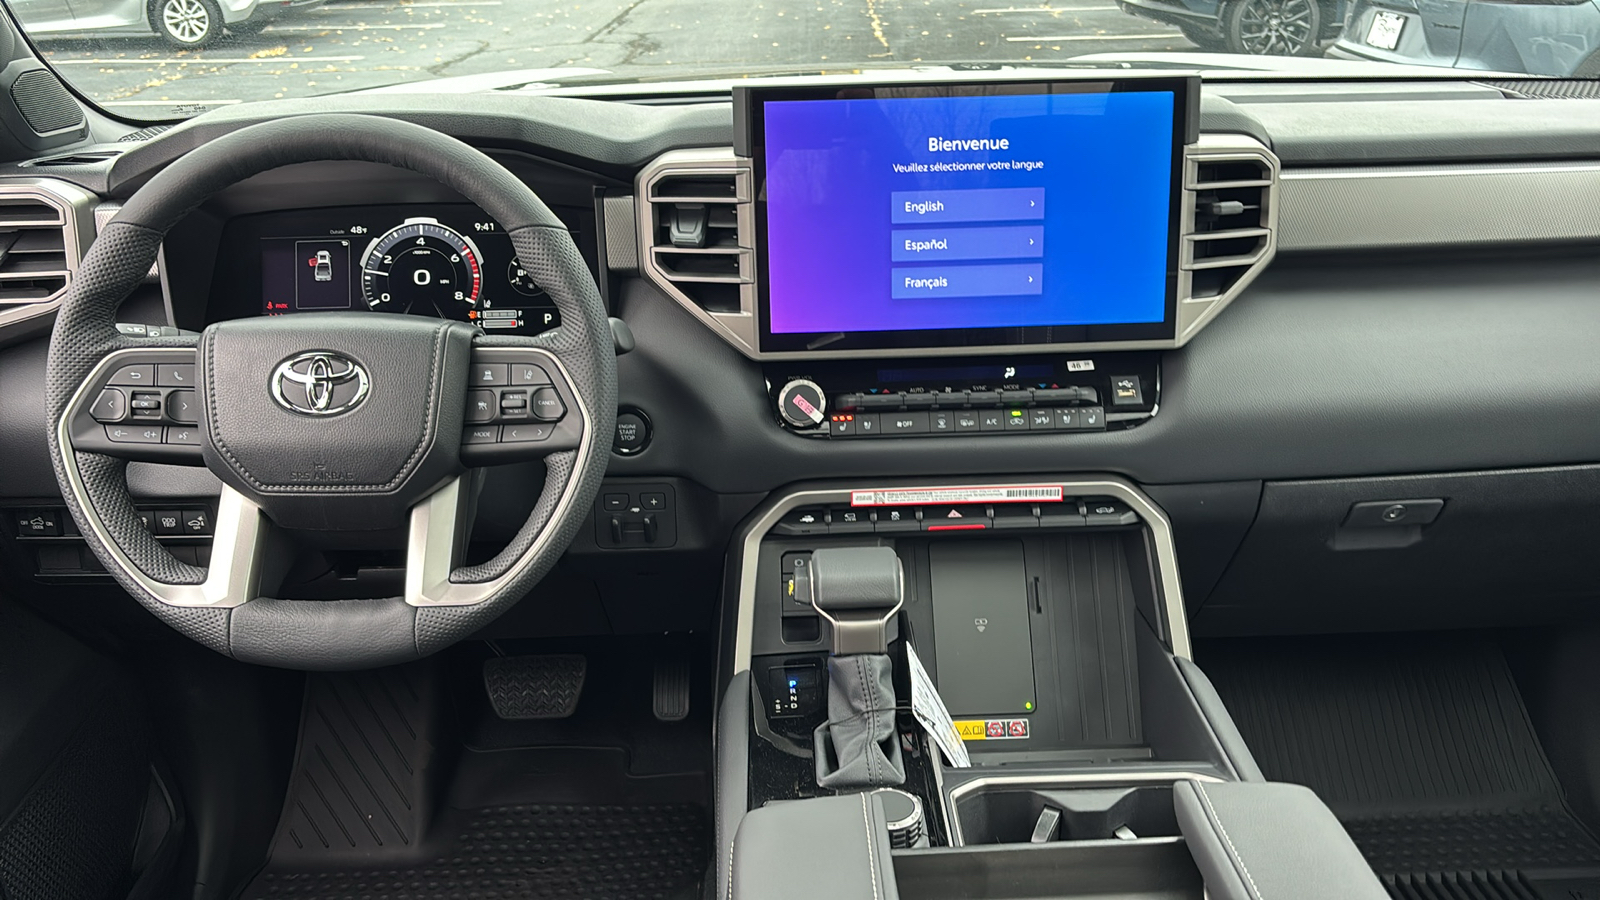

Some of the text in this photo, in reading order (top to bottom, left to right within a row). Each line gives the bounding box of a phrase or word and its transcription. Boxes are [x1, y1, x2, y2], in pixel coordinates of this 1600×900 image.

[928, 136, 1010, 152] Bienvenue
[892, 159, 1045, 173] Veuillez sélectionner votre langue
[904, 200, 945, 215] English
[474, 222, 495, 232] 9:41
[416, 237, 426, 246] 4
[904, 238, 948, 253] Español
[383, 255, 393, 264] 2
[450, 253, 460, 262] 6
[413, 269, 431, 286] 0
[904, 276, 949, 290] Français
[381, 293, 391, 302] 0
[454, 291, 464, 300] 8
[518, 319, 525, 327] H
[544, 313, 553, 325] P
[902, 420, 913, 428] OFF
[986, 418, 998, 426] A/C
[313, 472, 354, 481] AIRBAG
